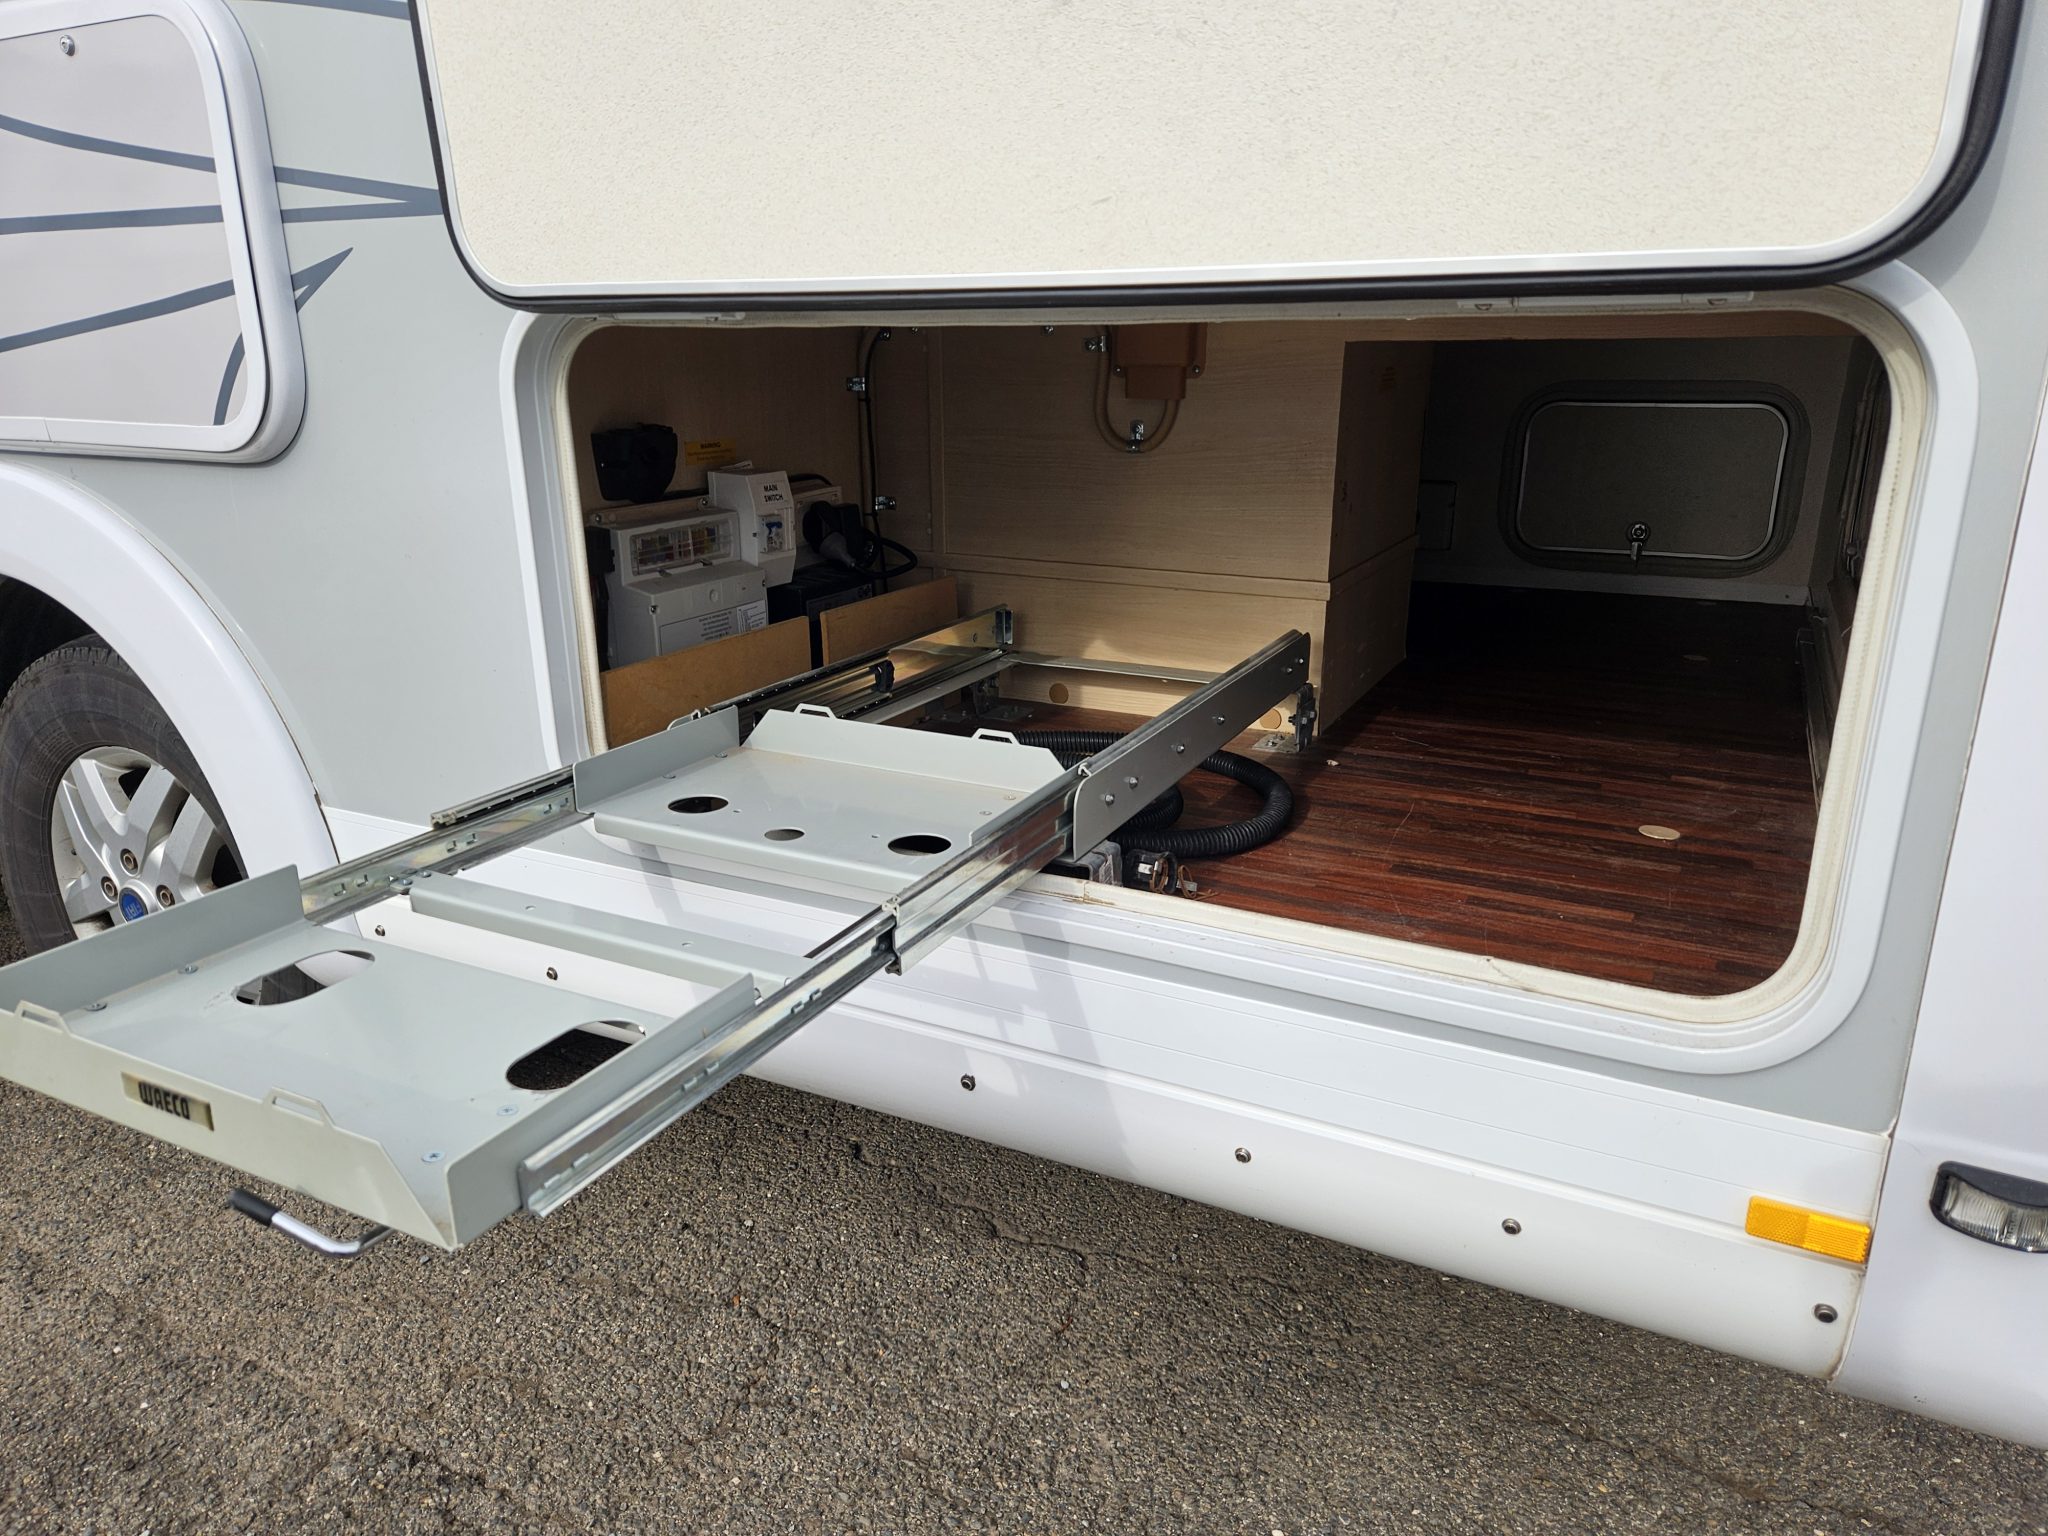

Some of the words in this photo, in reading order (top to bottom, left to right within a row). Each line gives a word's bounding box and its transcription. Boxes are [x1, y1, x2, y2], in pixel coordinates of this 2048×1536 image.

[763, 484, 778, 492] MAIN
[764, 494, 784, 503] SWITCH
[138, 1080, 191, 1120] WAECO
